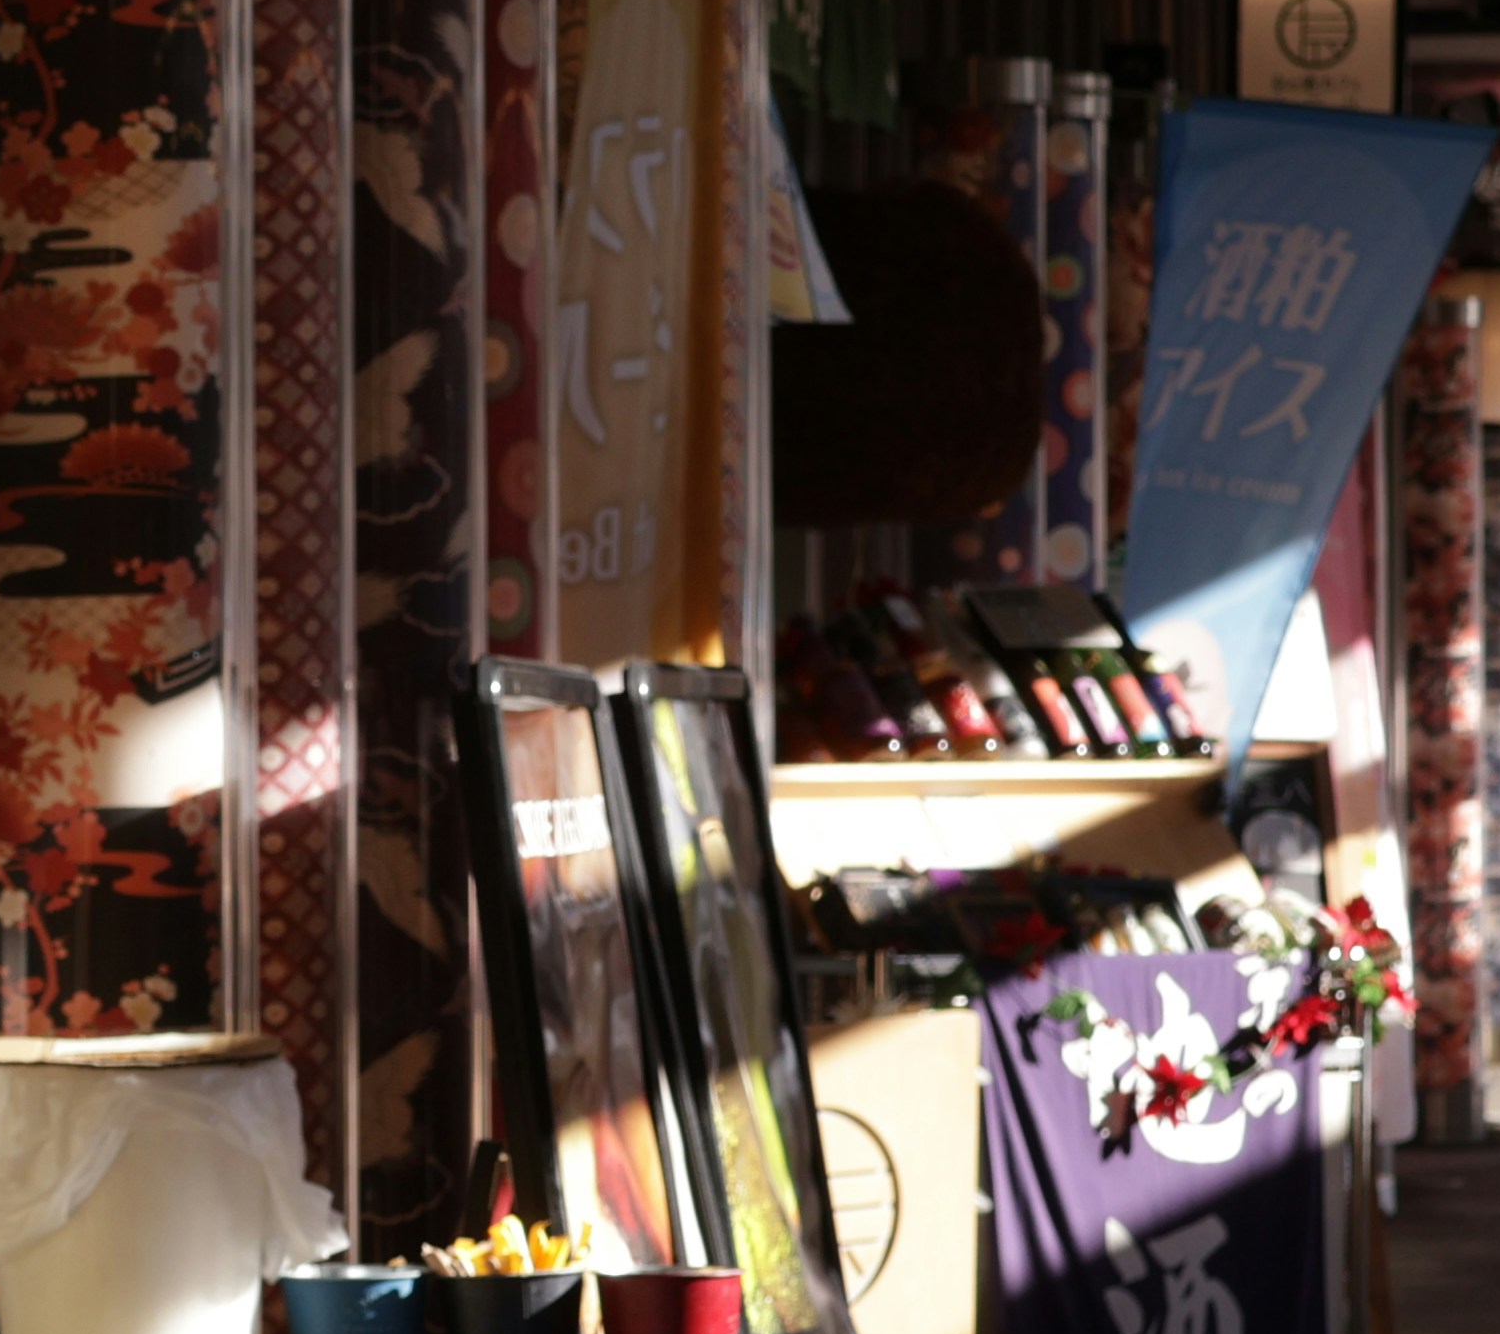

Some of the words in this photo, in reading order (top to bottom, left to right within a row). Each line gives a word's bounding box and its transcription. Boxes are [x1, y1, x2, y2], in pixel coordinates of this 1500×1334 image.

[1186, 218, 1357, 334] 酒粕
[1143, 344, 1326, 444] アイス
